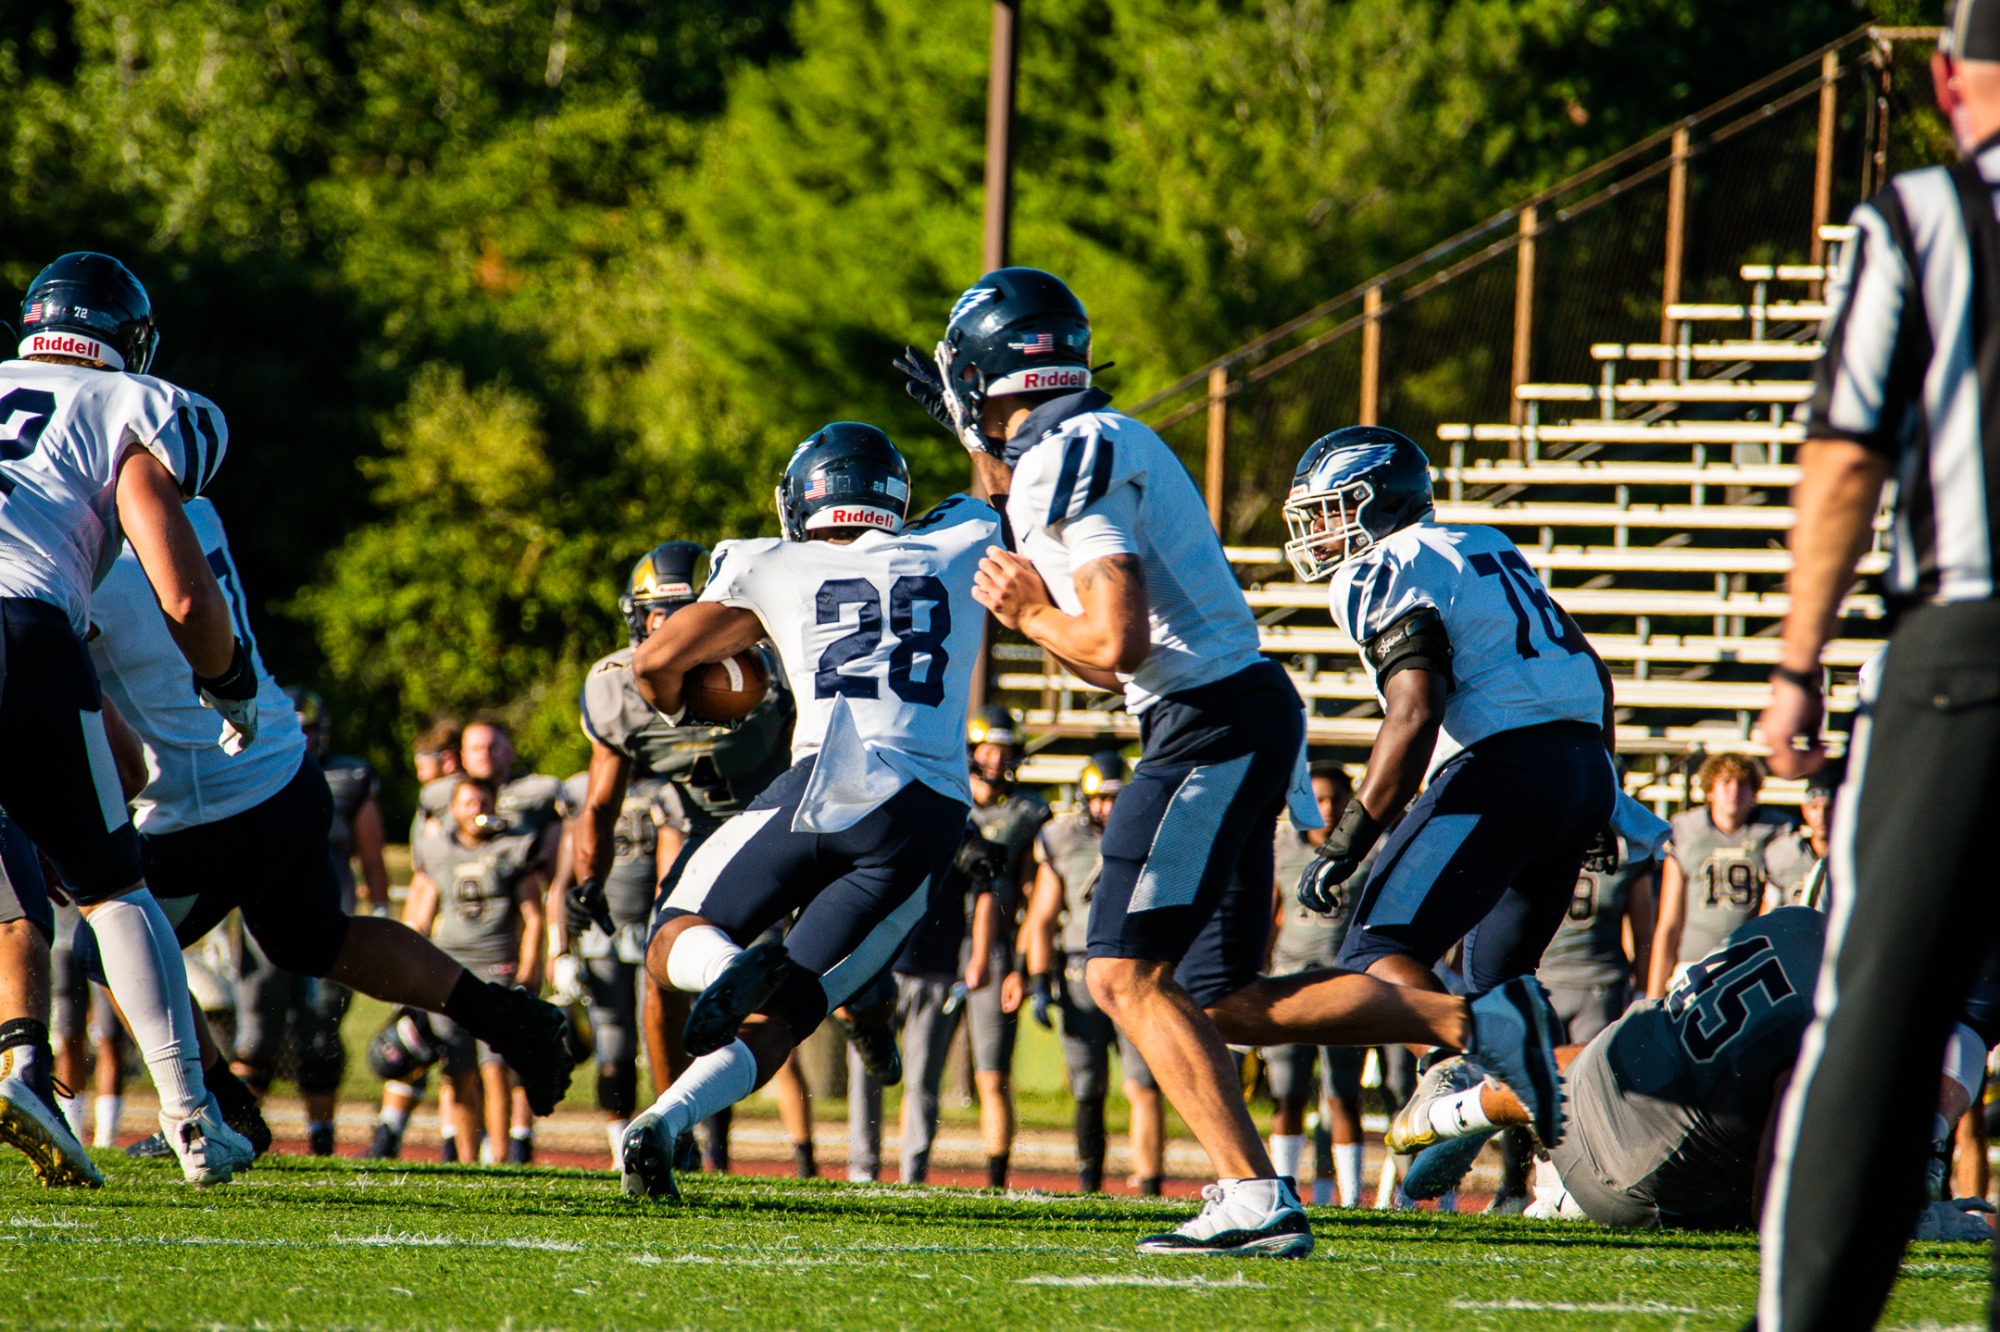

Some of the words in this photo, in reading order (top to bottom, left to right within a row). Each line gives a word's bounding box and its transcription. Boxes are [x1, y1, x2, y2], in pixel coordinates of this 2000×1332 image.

[74, 306, 88, 319] 72
[33, 336, 100, 358] Riddell
[1024, 370, 1087, 389] Riddell
[873, 481, 885, 493] 28
[814, 575, 951, 708] 28
[1700, 858, 1755, 910] 19
[1667, 935, 1797, 1064] 45
